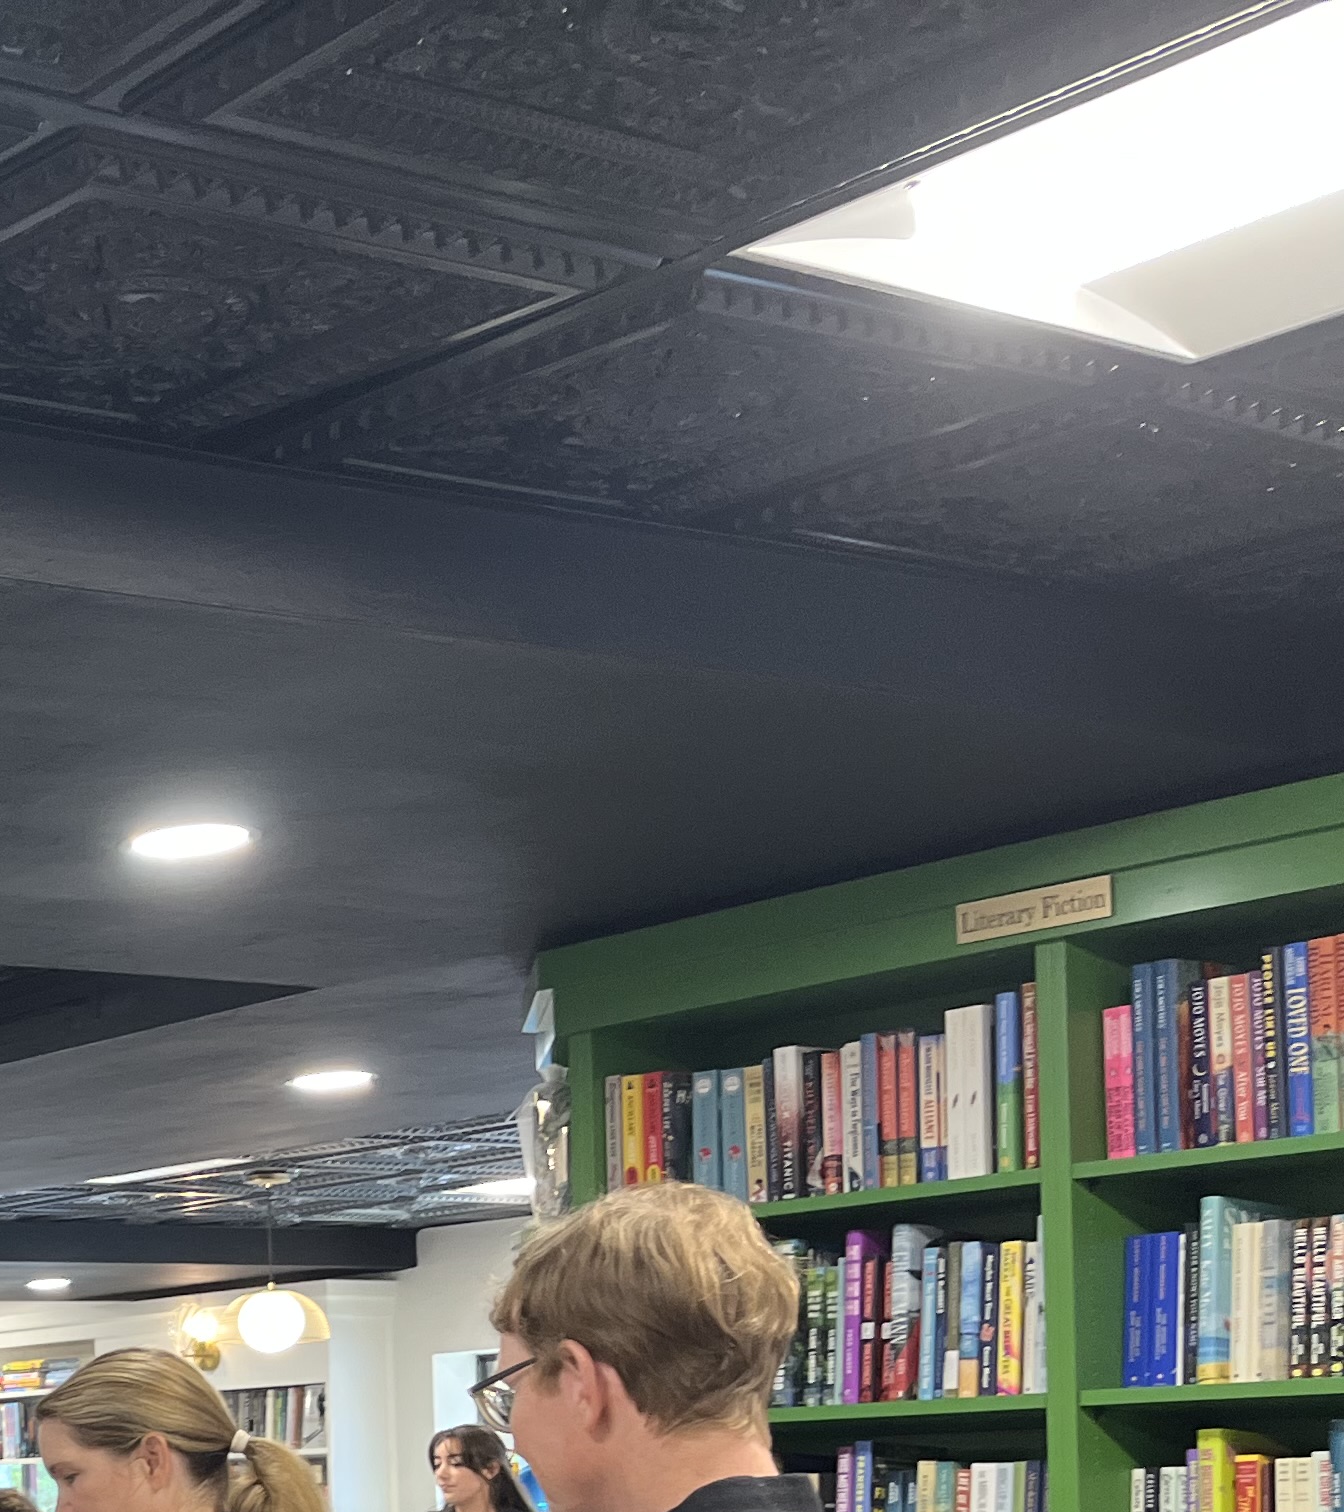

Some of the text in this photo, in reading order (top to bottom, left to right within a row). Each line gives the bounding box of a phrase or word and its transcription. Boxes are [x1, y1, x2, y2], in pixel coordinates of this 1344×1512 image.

[961, 889, 1106, 934] Literary Fiction
[1261, 954, 1276, 1004] PEOPLE
[1192, 987, 1206, 1058] JOJO MOYES
[1213, 985, 1226, 1048] Jojo Moyes
[1264, 1009, 1277, 1037] LIKE
[1286, 987, 1309, 1039] LOVED
[1231, 983, 1250, 1121] JOJO MOYES After You
[1289, 1042, 1309, 1075] ONE
[924, 1099, 935, 1140] ALLIANCE
[783, 1141, 793, 1190] TITANIC
[984, 1254, 995, 1280] Maybe
[1292, 1228, 1307, 1330] HELLO BEAUTIFUL
[1311, 1226, 1327, 1328] HELLO BEAUTIFUL
[984, 1282, 994, 1302] Next
[984, 1303, 994, 1320] Time
[1002, 1299, 1012, 1327] GREAT
[855, 1456, 866, 1502] FRANCES
[957, 1472, 970, 1492] LIFE
